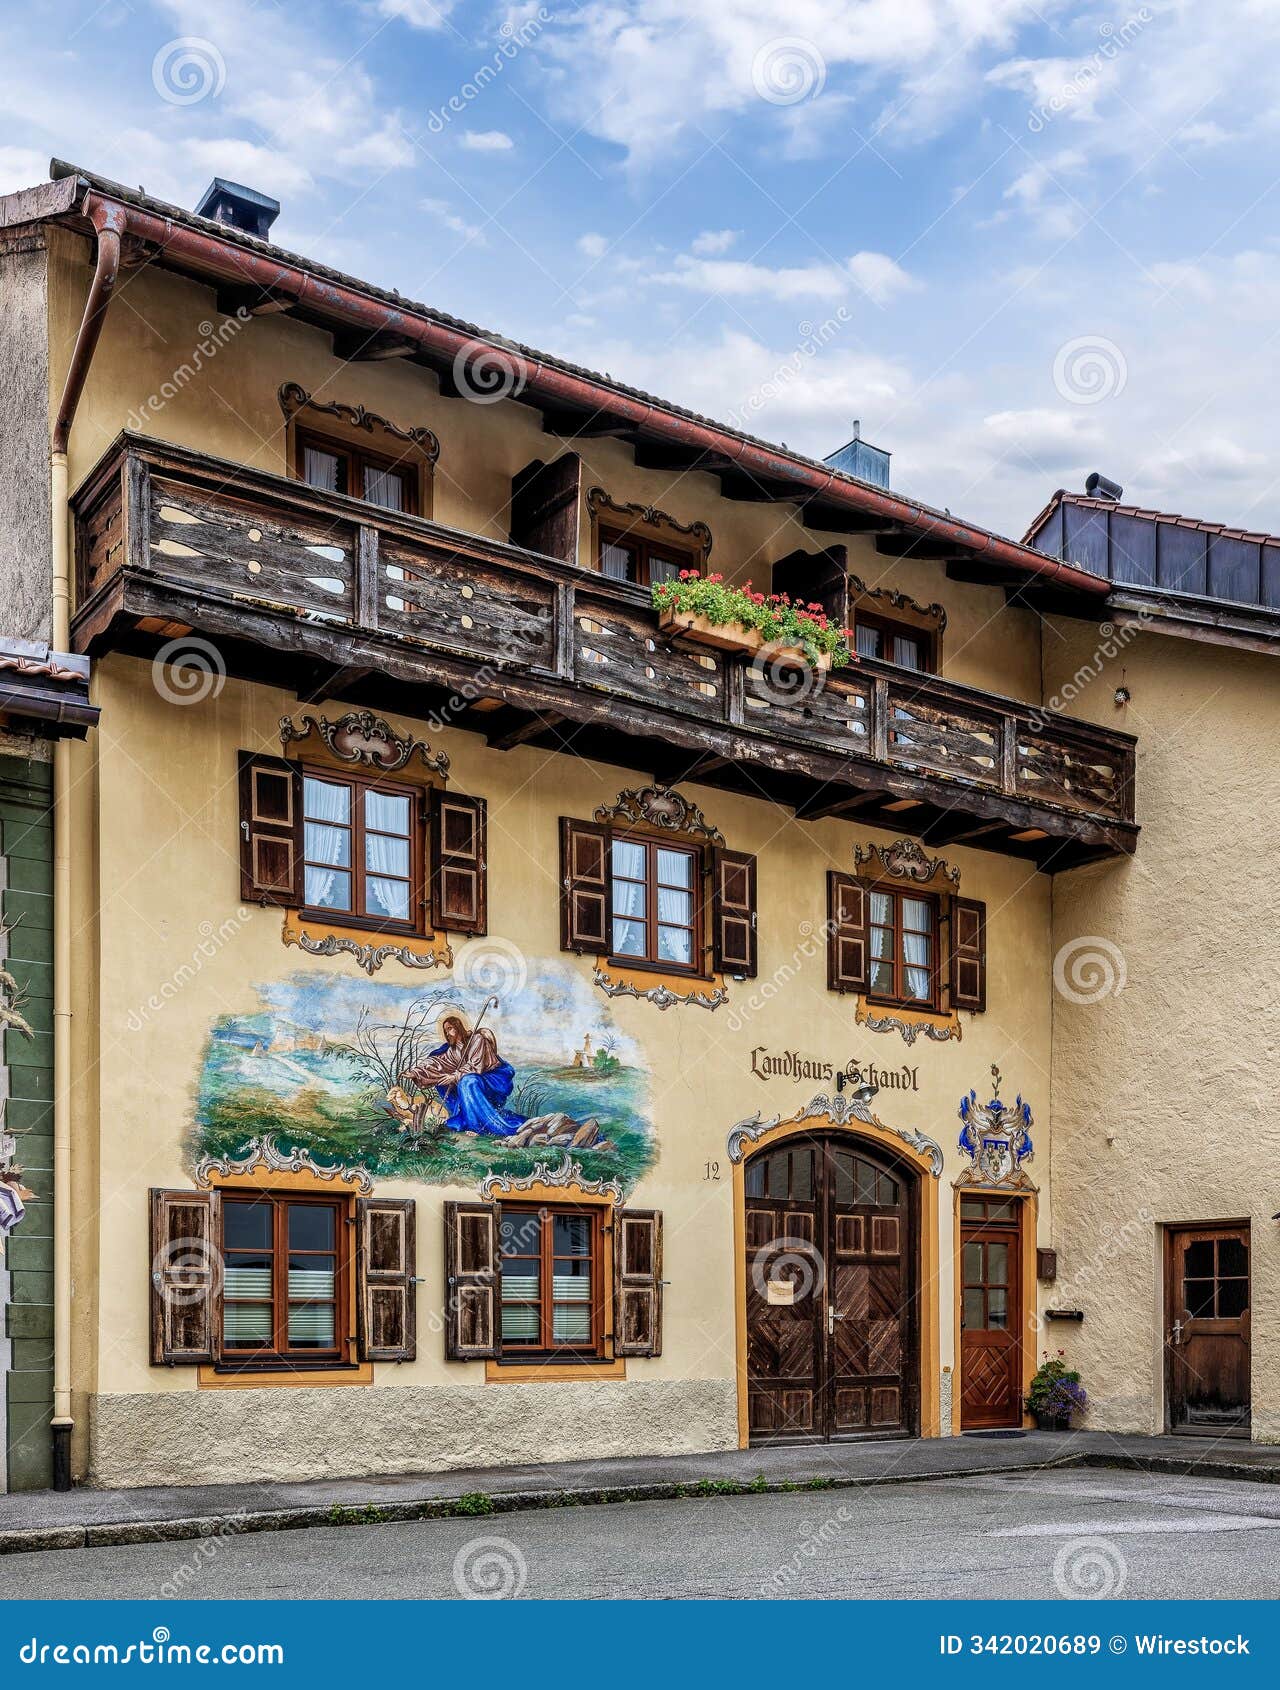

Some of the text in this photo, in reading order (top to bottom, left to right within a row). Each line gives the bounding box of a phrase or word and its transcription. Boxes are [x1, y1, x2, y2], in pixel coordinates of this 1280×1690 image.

[751, 1046, 919, 1092] Landhaus Schandl
[703, 1161, 721, 1180] 12
